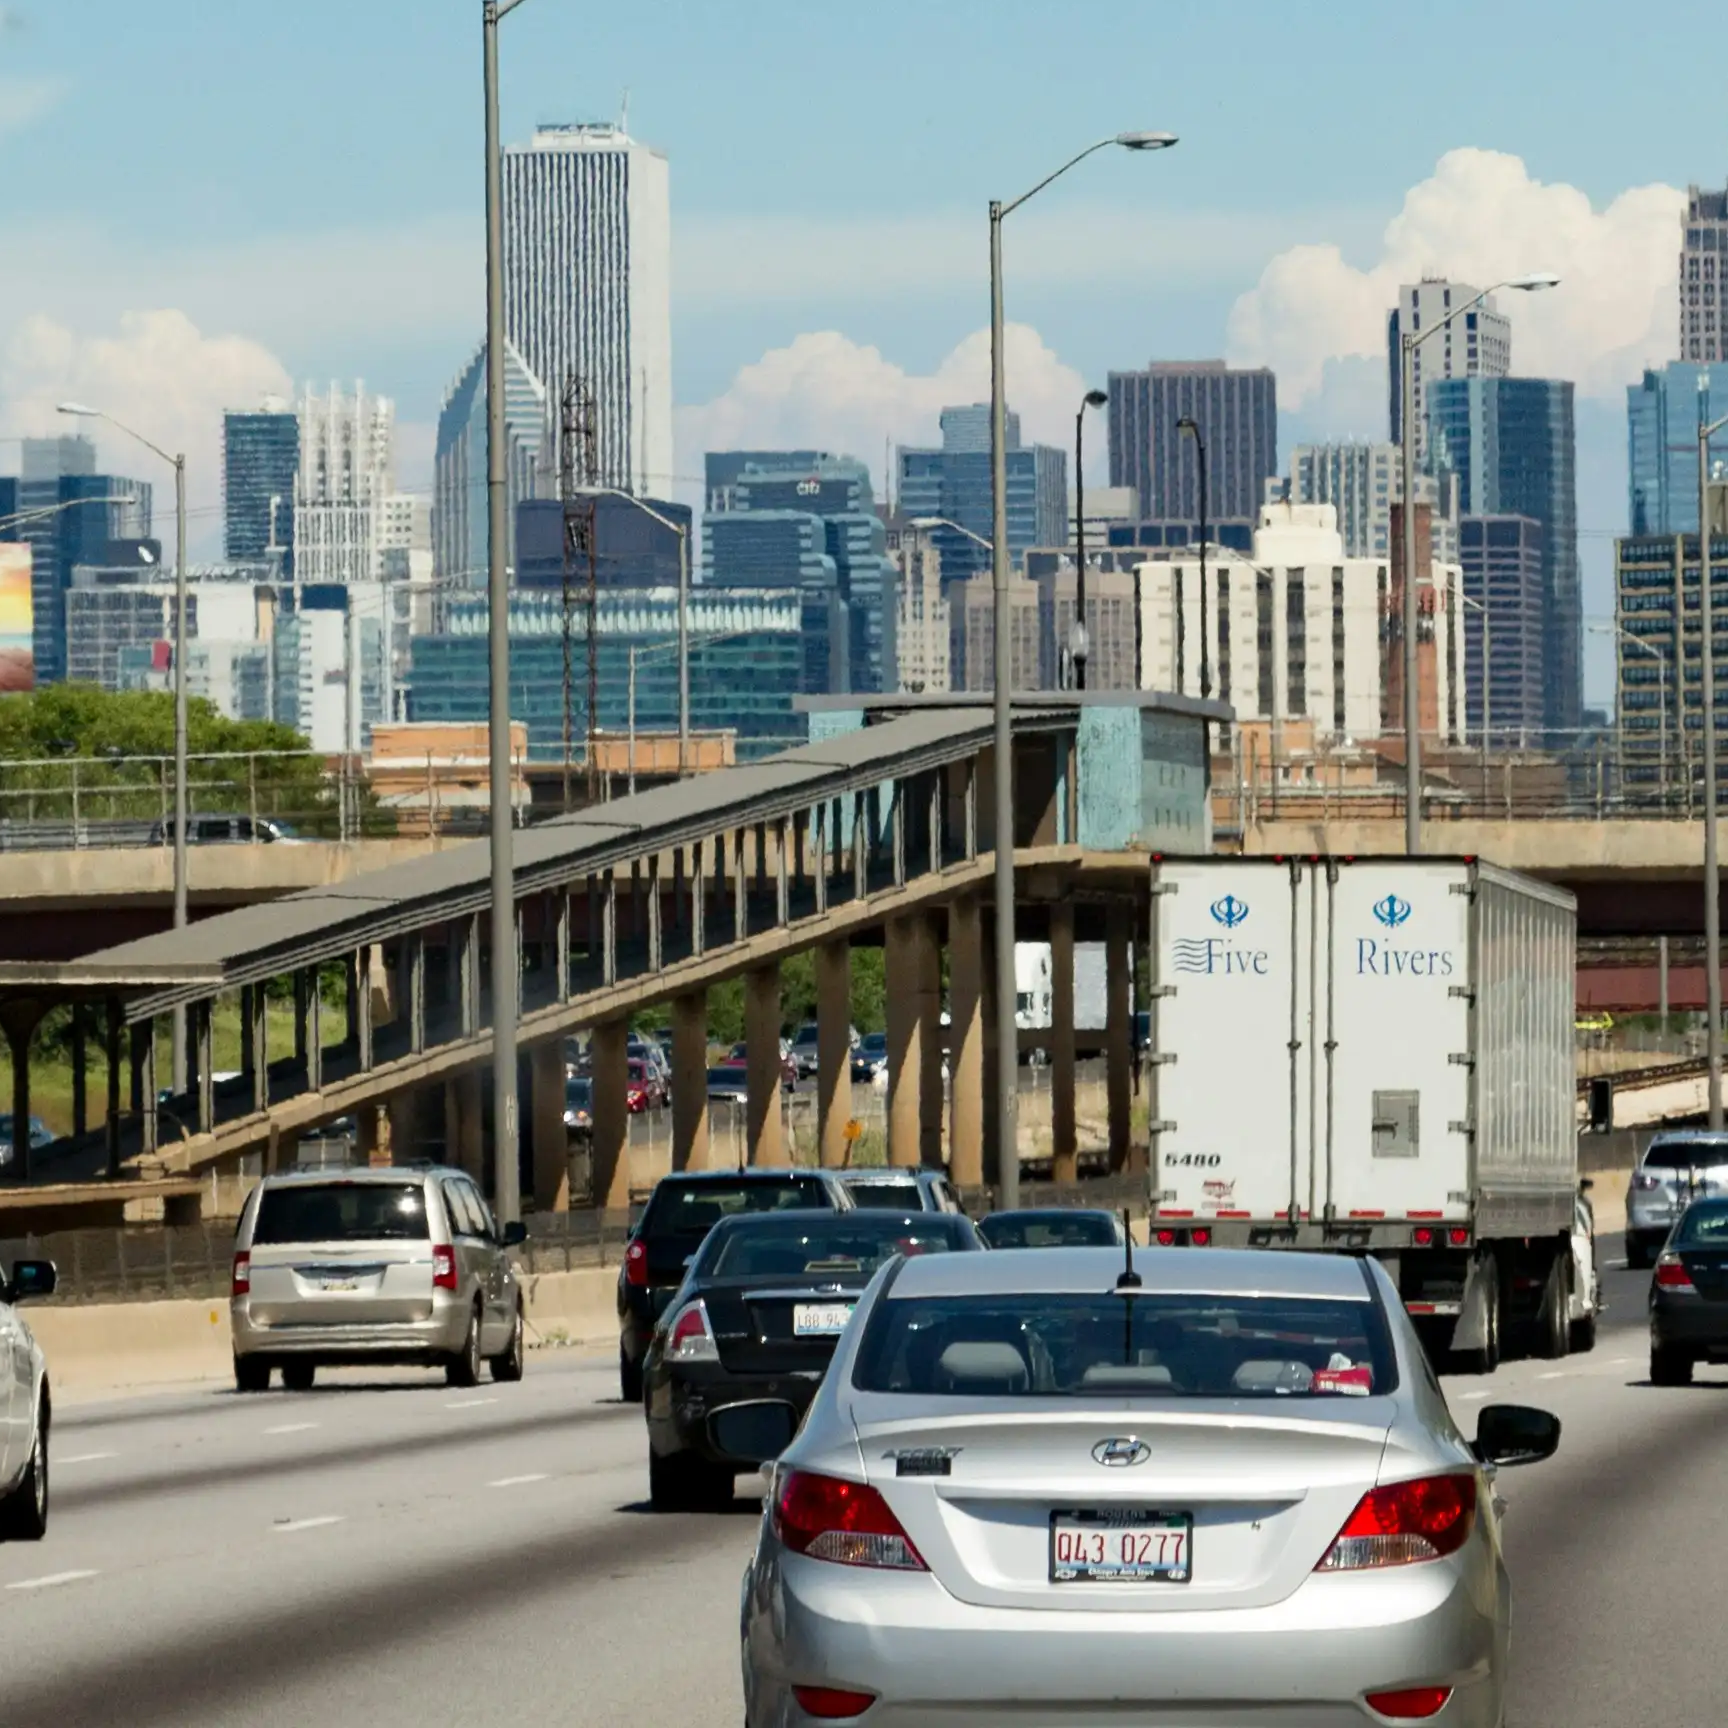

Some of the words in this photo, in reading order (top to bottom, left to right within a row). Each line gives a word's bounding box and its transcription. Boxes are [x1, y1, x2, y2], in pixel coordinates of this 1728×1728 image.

[1205, 938, 1268, 974] Five
[1356, 937, 1453, 975] Rivers
[1057, 1532, 1105, 1565] Q43
[1121, 1532, 1186, 1565] 0277
